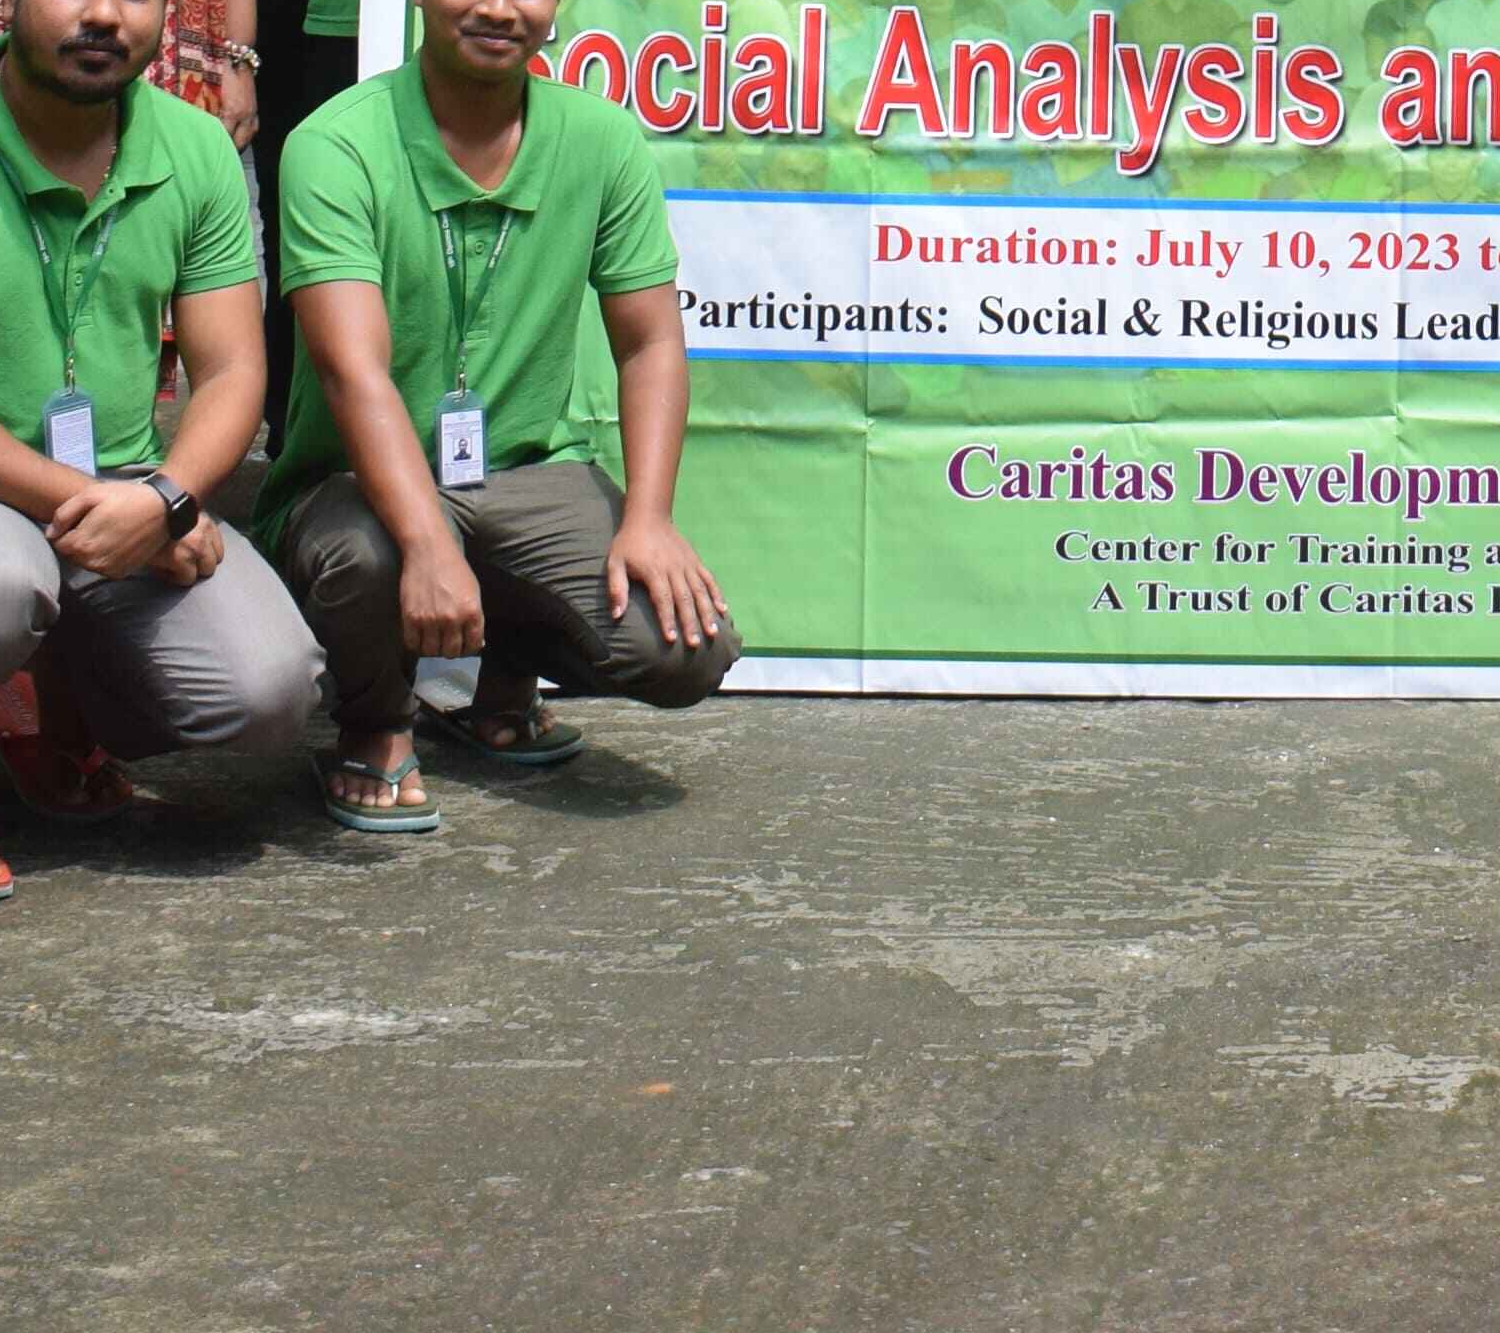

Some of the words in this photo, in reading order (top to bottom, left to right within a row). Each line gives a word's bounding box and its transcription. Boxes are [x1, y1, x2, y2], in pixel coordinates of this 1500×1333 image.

[855, 7, 1345, 173] Analysis
[874, 222, 1118, 267] Duration:
[1135, 227, 1242, 279] July
[1261, 230, 1331, 279] 10,
[1348, 231, 1462, 272] 2023
[677, 288, 948, 343] Participants:
[978, 296, 1107, 336] Social
[1122, 297, 1161, 338] &
[1180, 299, 1379, 349] Religious
[946, 444, 1176, 503] Caritas
[1054, 532, 1201, 563] Center
[1213, 532, 1277, 564] for
[1289, 533, 1472, 574] Training
[1092, 581, 1125, 613] A
[1137, 580, 1250, 613] Trust
[1265, 583, 1311, 614] of
[1318, 583, 1474, 615] Caritas
